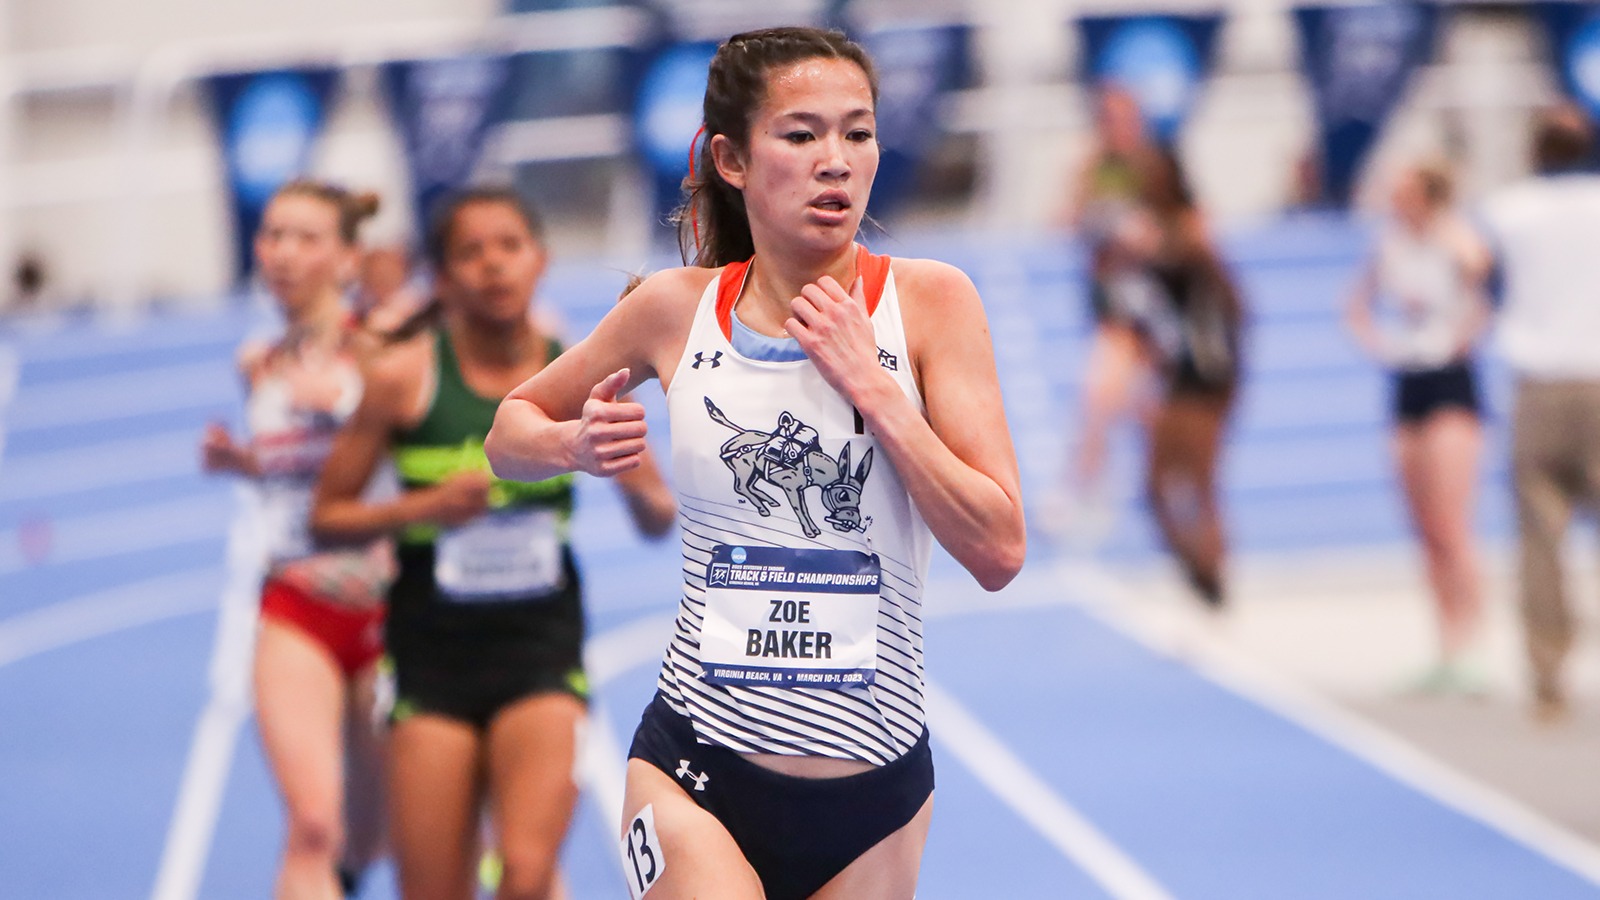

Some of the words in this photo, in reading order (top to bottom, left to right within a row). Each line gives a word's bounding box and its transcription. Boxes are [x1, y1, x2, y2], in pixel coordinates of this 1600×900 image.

[730, 569, 760, 582] TRACK
[760, 572, 768, 583] &
[768, 572, 795, 584] FIELD
[796, 572, 879, 587] CHAMPIONSHIPS
[769, 600, 810, 624] ZOE
[745, 629, 832, 659] BAKER
[714, 669, 744, 680] VIRGINIA
[745, 671, 771, 682] BEACH,
[772, 673, 783, 682] VA
[796, 673, 824, 683] MARCH
[842, 673, 863, 682] 2023
[627, 817, 656, 893] 13
